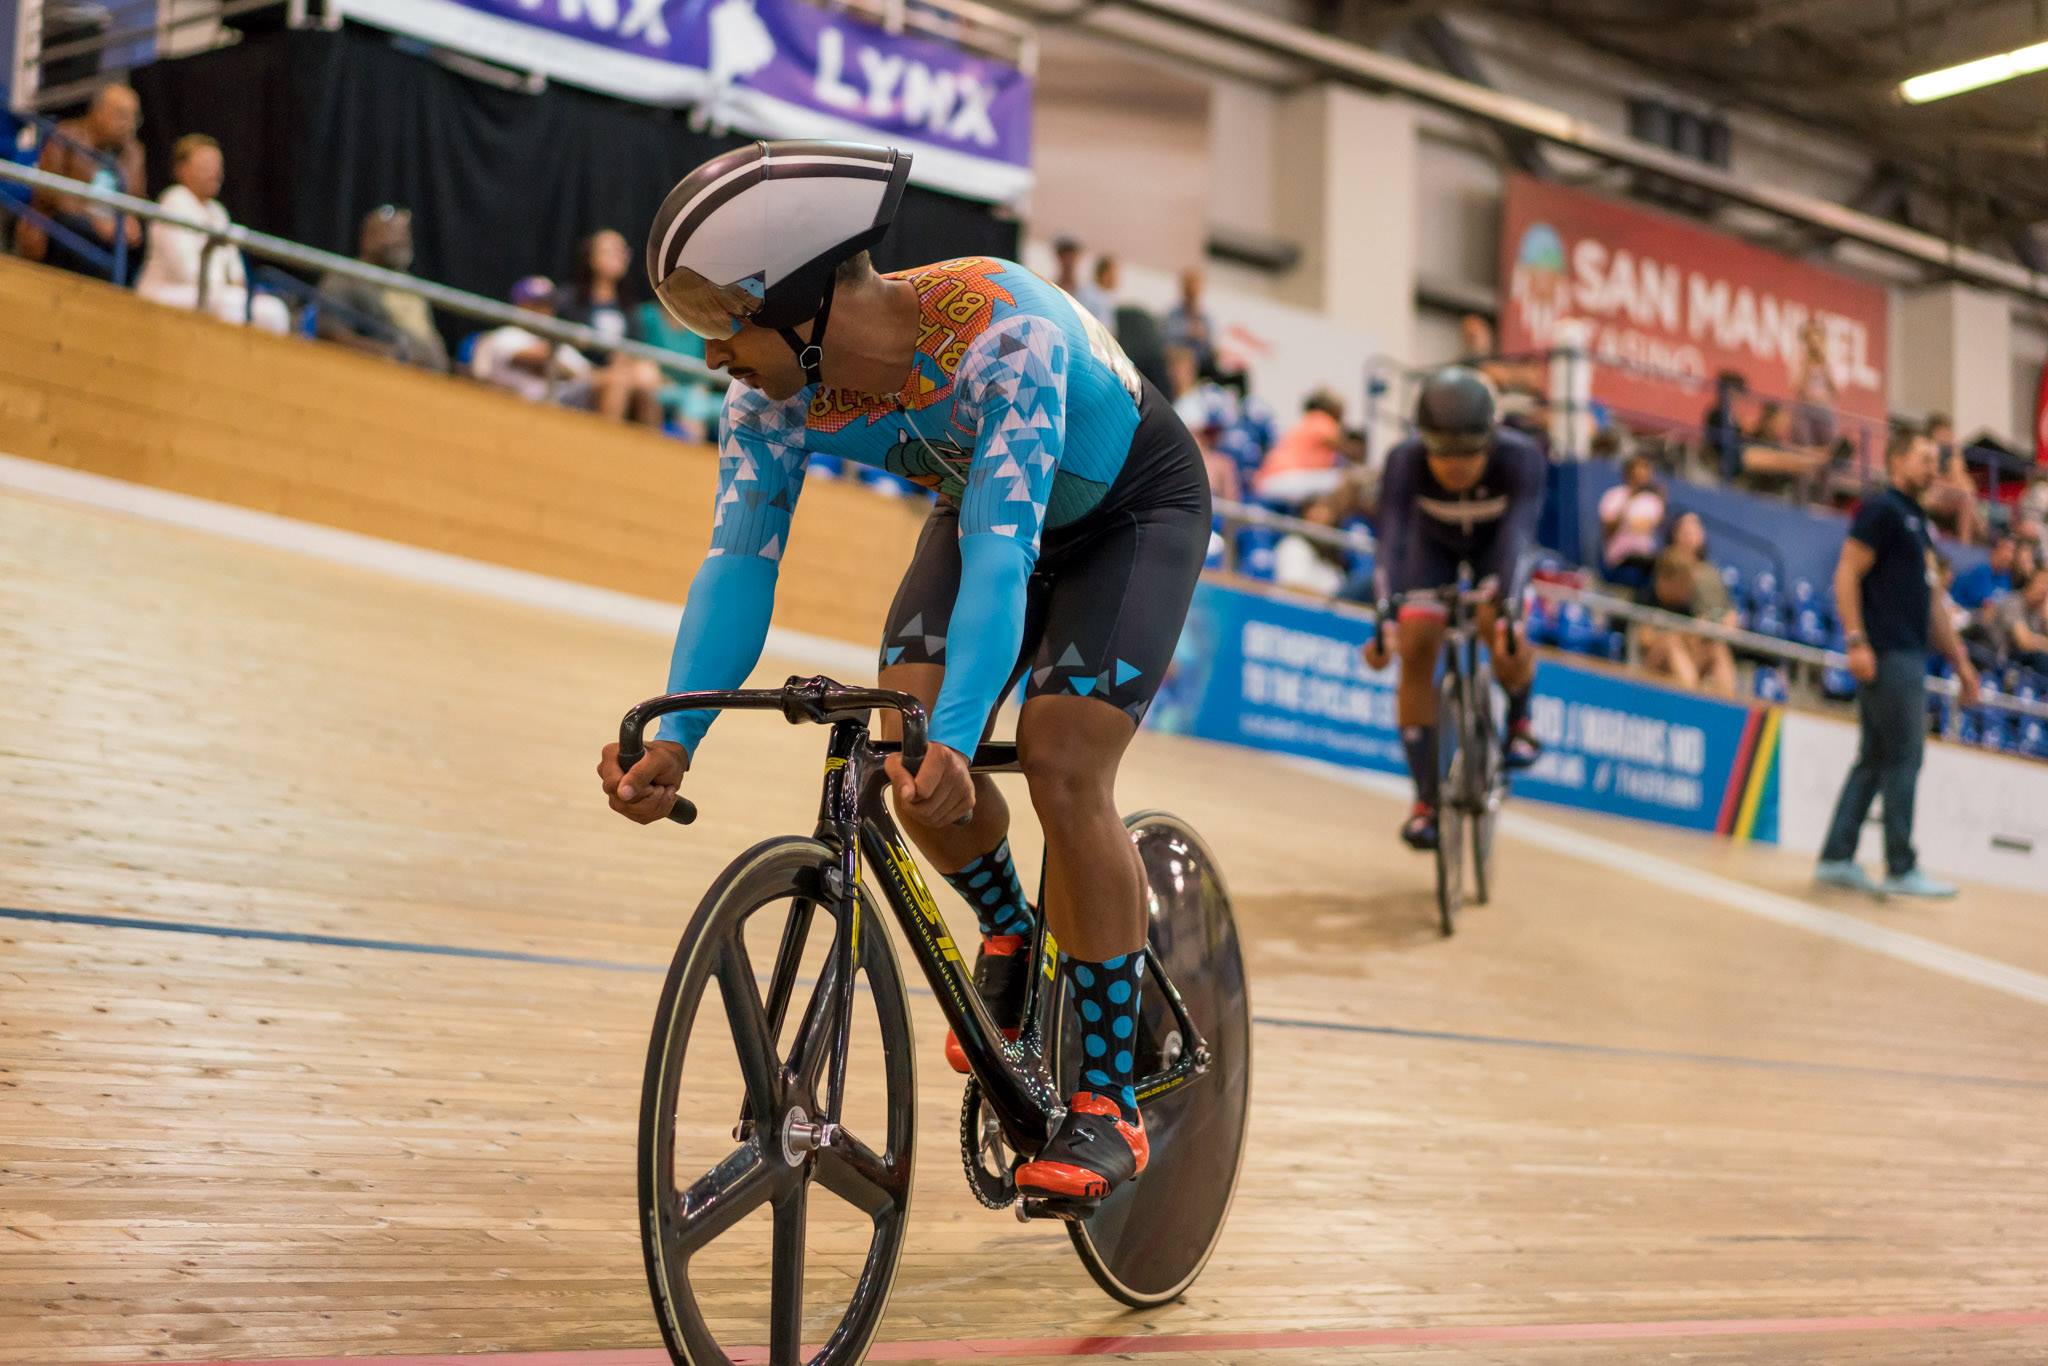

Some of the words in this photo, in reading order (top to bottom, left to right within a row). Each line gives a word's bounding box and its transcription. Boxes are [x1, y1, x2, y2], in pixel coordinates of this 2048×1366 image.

[815, 26, 998, 146] LYNX
[1573, 239, 1681, 333] SAN
[1582, 316, 1706, 394] ASINO
[886, 858, 901, 881] BIKE
[900, 883, 939, 959] TECHNOLOGIES
[938, 961, 966, 1013] AUSTRALIA
